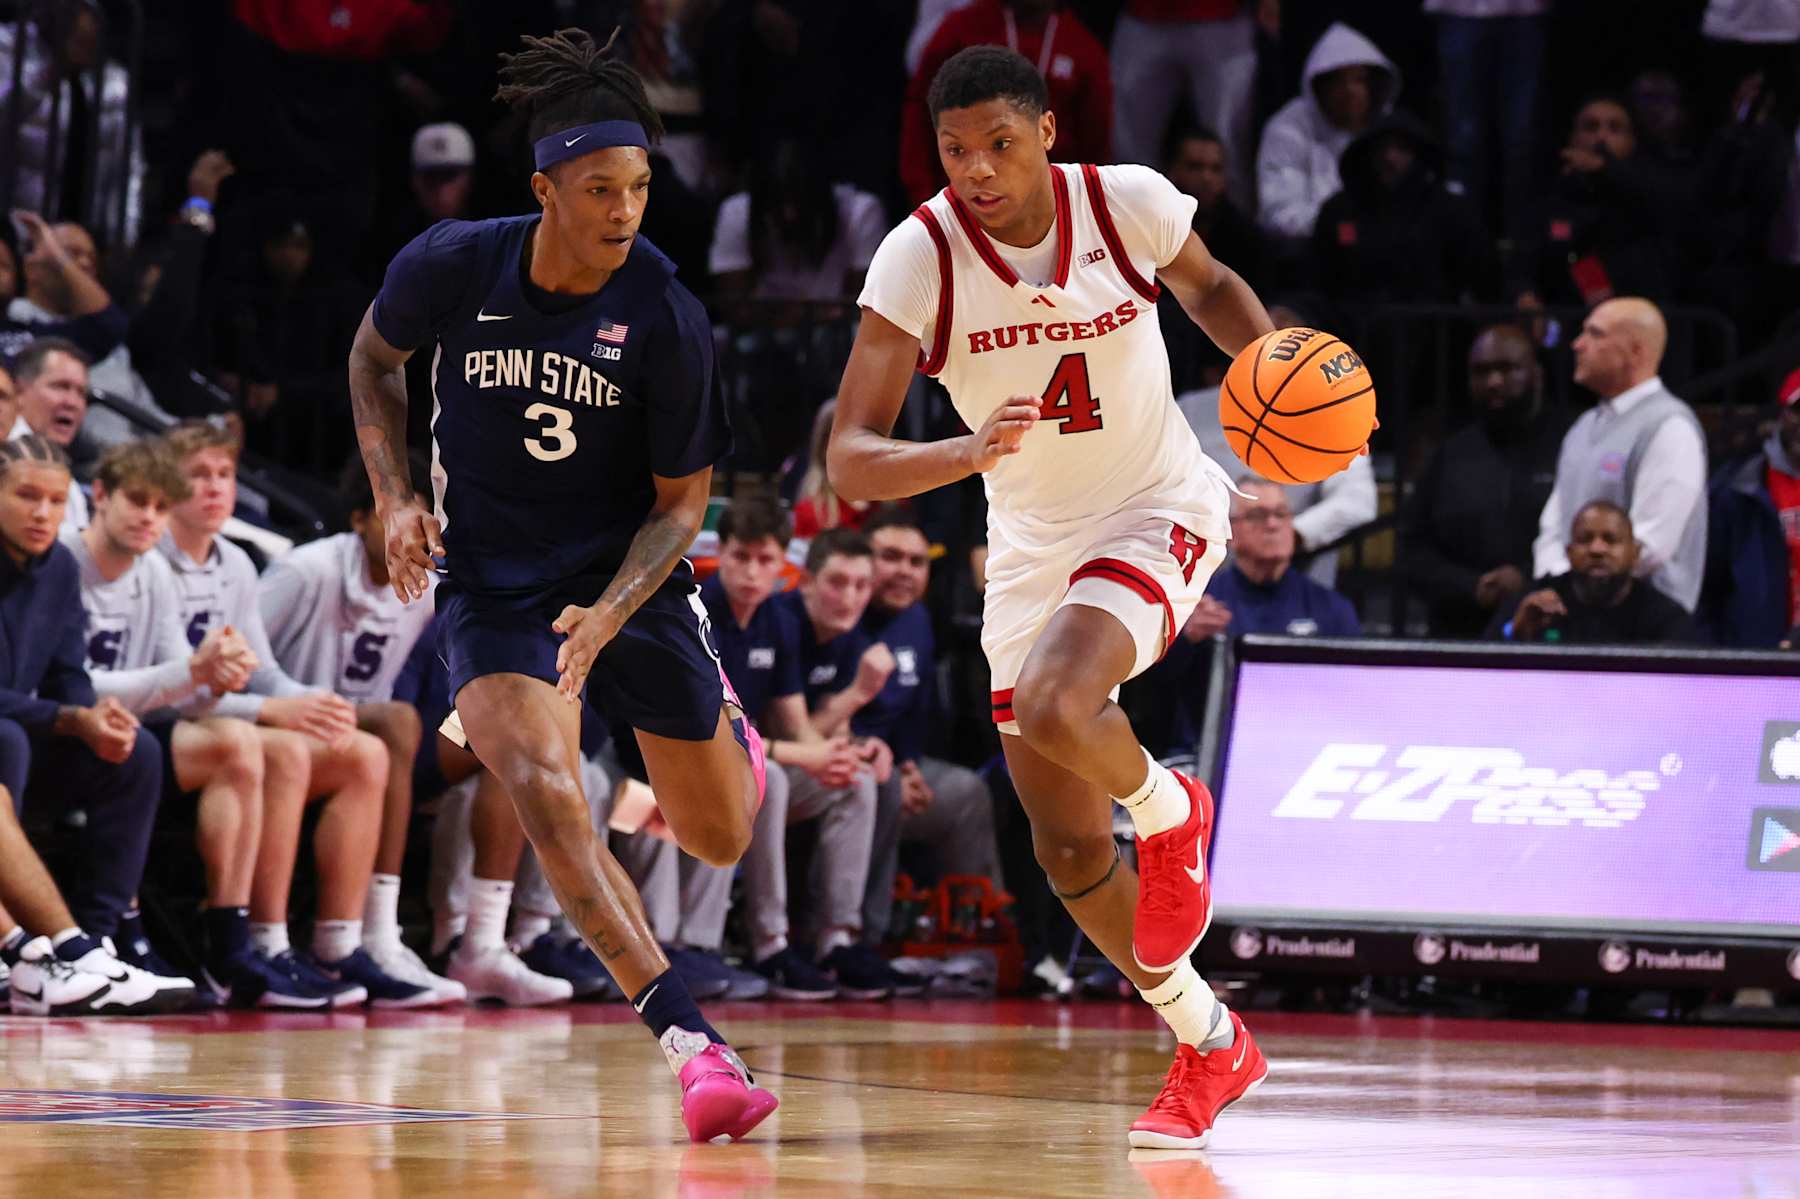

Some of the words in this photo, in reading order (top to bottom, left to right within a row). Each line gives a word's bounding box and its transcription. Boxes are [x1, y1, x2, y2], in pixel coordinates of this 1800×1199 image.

[967, 299, 1139, 354] RUTGERS
[465, 349, 534, 389] PENN
[540, 351, 623, 408] STATE
[1036, 352, 1104, 435] 4
[524, 402, 578, 462] 3
[345, 631, 389, 682] S
[1266, 934, 1356, 958] Prudential
[1451, 940, 1540, 963] Prudential
[1636, 948, 1727, 971] Prudential
